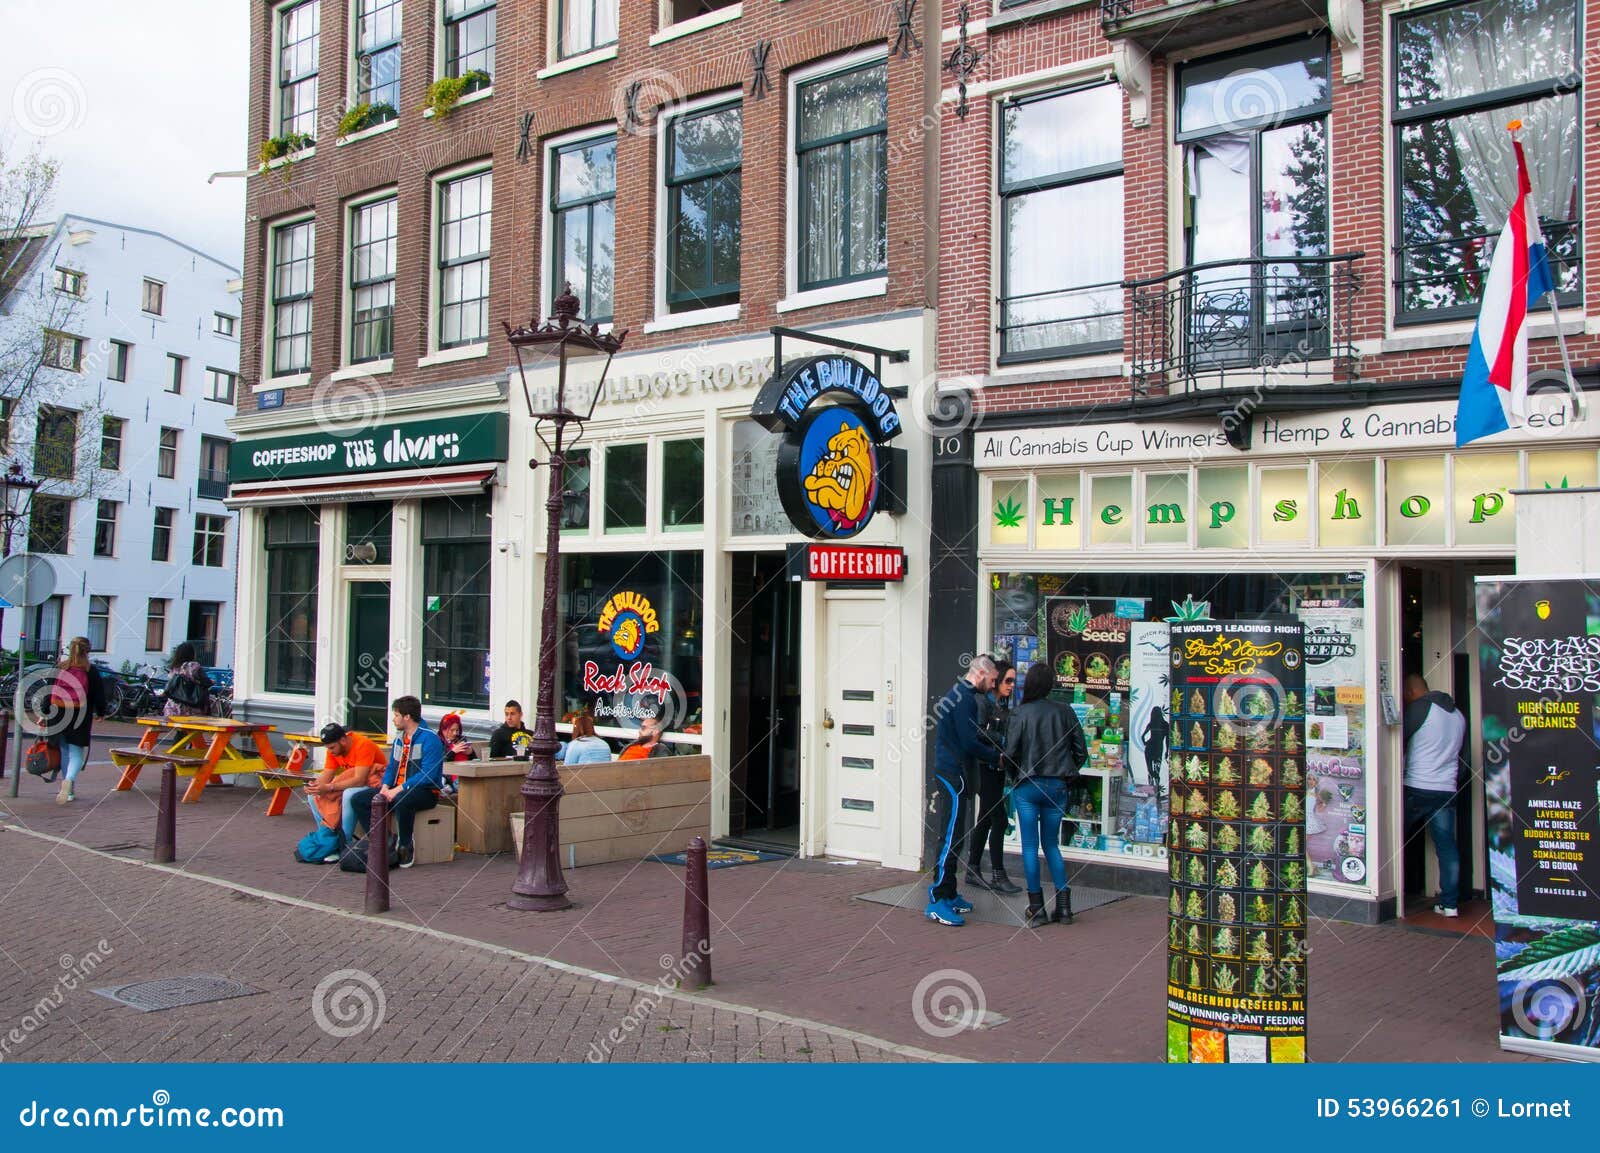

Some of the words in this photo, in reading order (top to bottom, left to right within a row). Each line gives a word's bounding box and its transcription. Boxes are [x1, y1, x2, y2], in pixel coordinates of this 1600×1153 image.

[779, 369, 819, 422] THE
[816, 358, 900, 434] BULLDOG
[1262, 418, 1330, 446] Hemp
[1339, 416, 1356, 439] &
[1364, 412, 1457, 437] Cannabi
[983, 436, 1003, 458] All
[1009, 434, 1089, 457] Cannabis
[1096, 430, 1134, 455] Cup
[1141, 428, 1229, 451] Winners
[252, 443, 337, 467] COFFEESHOP
[342, 438, 377, 468] THE
[809, 549, 902, 577] COFFEESHOP
[598, 600, 618, 632] THE
[613, 591, 660, 633] BULLDOG
[1183, 624, 1222, 633] WORLD'S
[1224, 624, 1272, 633] LEADING
[1274, 625, 1301, 634] HIGH!
[1081, 629, 1126, 643] Seeds
[1304, 634, 1351, 645] RADISE
[1502, 636, 1600, 657] SOMA'S
[1498, 655, 1600, 675] SACRED
[583, 660, 627, 693] Rock
[628, 661, 671, 705] Shop
[1055, 674, 1080, 683] Indica
[1086, 676, 1111, 685] Skunk
[1116, 678, 1130, 687] Sat
[1493, 671, 1600, 693] SEEDS
[1518, 702, 1544, 714] HIGH
[1546, 702, 1580, 714] GRADE
[1523, 716, 1577, 729] ORGANICS
[1528, 799, 1561, 809] AMNESIA
[1562, 801, 1582, 810] HAZE
[1536, 810, 1575, 819] LAVENDER
[1534, 820, 1550, 829] NYC
[1551, 821, 1578, 830] DIESEL
[1523, 829, 1562, 839] BUDDHA'S
[1563, 831, 1590, 841] SISTER
[1538, 841, 1576, 850] SOMANGO
[1533, 850, 1584, 861] SOMALICIOUS
[1539, 860, 1549, 870] SO
[1551, 861, 1578, 871] GOUDA
[1534, 887, 1587, 897] SOMASEEDS.EU
[1168, 985, 1305, 1011] WWW.GREENHOUSESEEDS.NL
[1168, 1000, 1188, 1014] AWARD
[1188, 1006, 1230, 1022] WINNING
[1231, 1013, 1264, 1025] PLANT
[1266, 1015, 1305, 1025] FEEDING
